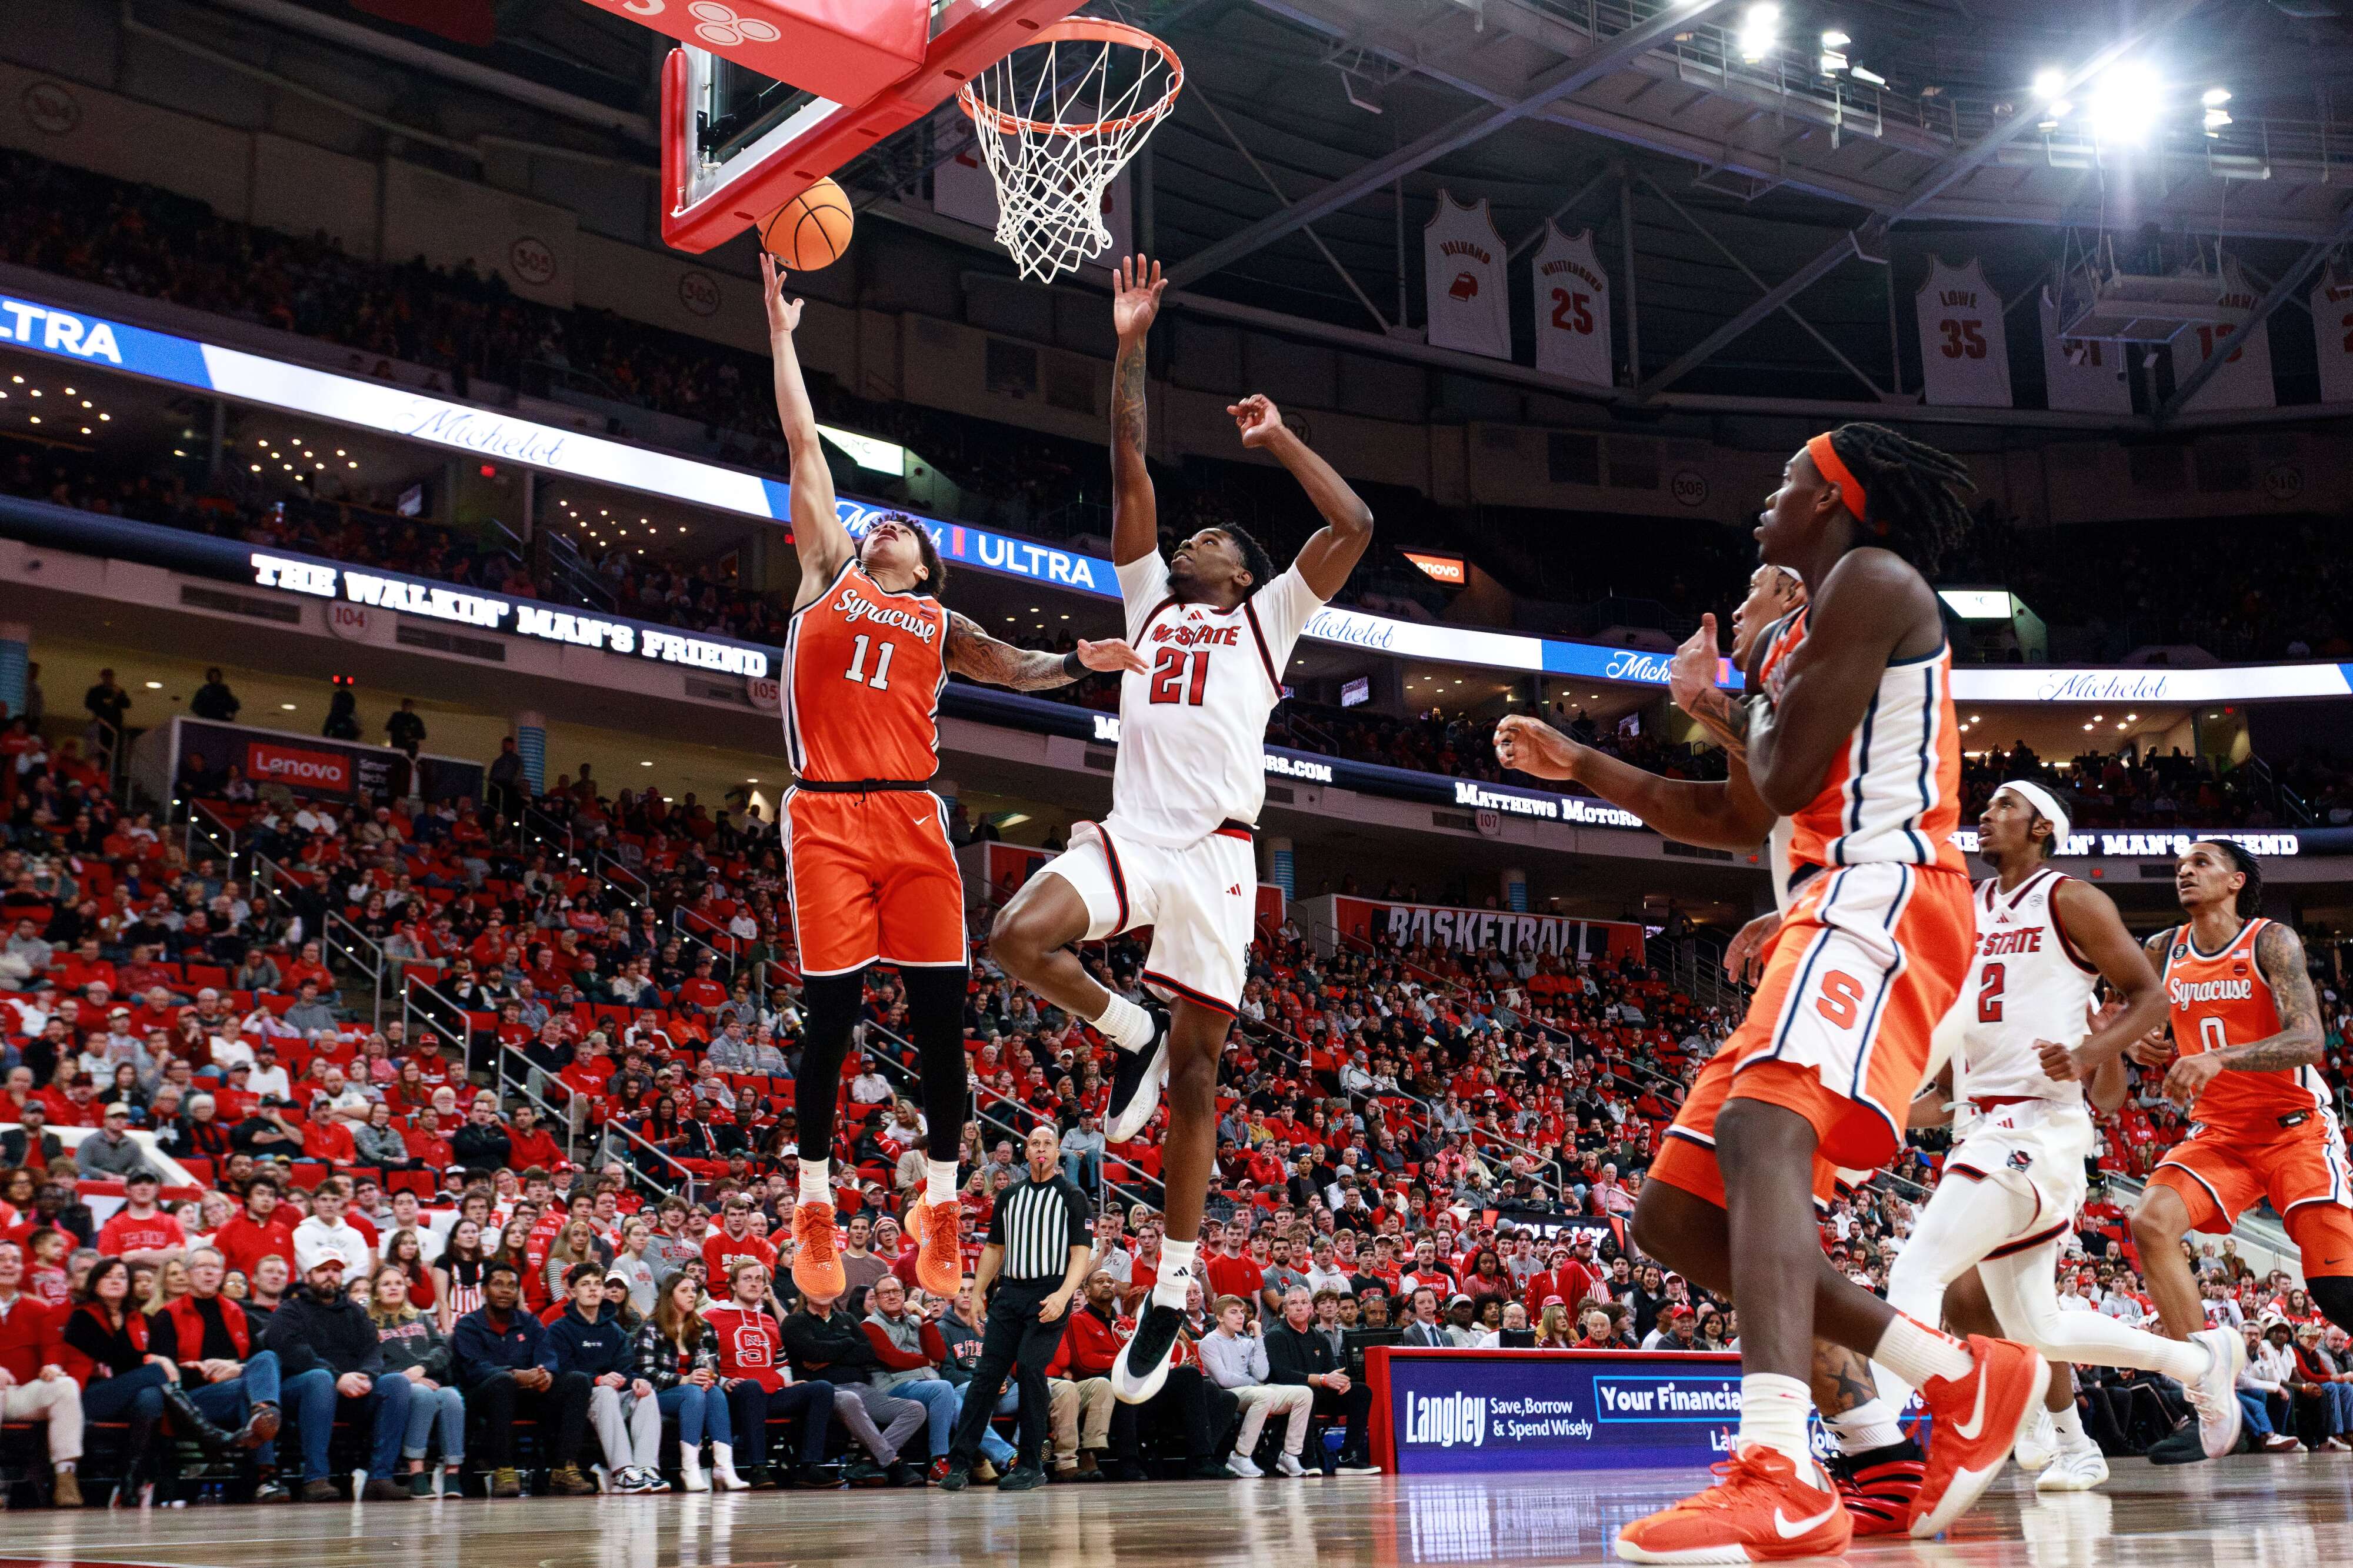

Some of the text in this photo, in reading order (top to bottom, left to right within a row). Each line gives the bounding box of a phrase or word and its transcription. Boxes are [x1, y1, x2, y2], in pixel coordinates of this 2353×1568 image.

[1440, 240, 1491, 264] VALVANO
[1551, 287, 1594, 335] 25
[1939, 290, 1977, 309] LOWE
[0, 300, 122, 363] TRA
[1939, 319, 1987, 359] 35
[392, 399, 565, 465] Michelob
[978, 534, 1095, 588] ULTRA
[1415, 560, 1459, 578] enovo
[251, 553, 768, 678] THE WALKIN' MAN'S FRIEND
[335, 607, 365, 628] 104
[833, 589, 936, 644] Syracuse
[843, 633, 895, 691] 11
[1149, 646, 1210, 706] 21
[1606, 651, 1672, 682] Mich
[752, 682, 778, 700] 105
[2038, 672, 2167, 702] Michelob
[256, 752, 342, 782] Lenovo
[1262, 754, 1332, 782] RS.COM
[1455, 782, 1557, 818] MATTHEWS
[1479, 813, 1497, 828] 107
[1948, 831, 1980, 852] HE
[2102, 835, 2190, 855] MAN'S
[2197, 835, 2299, 855] END
[1388, 906, 1592, 961] BASKETBALL
[1982, 926, 2045, 956] STATE
[1816, 969, 1865, 1030] S
[1978, 962, 2006, 1023] 2
[2170, 976, 2252, 1010] Syracuse
[2199, 1016, 2228, 1055] 0
[1525, 1398, 1572, 1414] Borrow
[1600, 1382, 1742, 1412] Your Financia
[1406, 1390, 1485, 1447] Langley
[1493, 1418, 1593, 1441] & Spend Wisely
